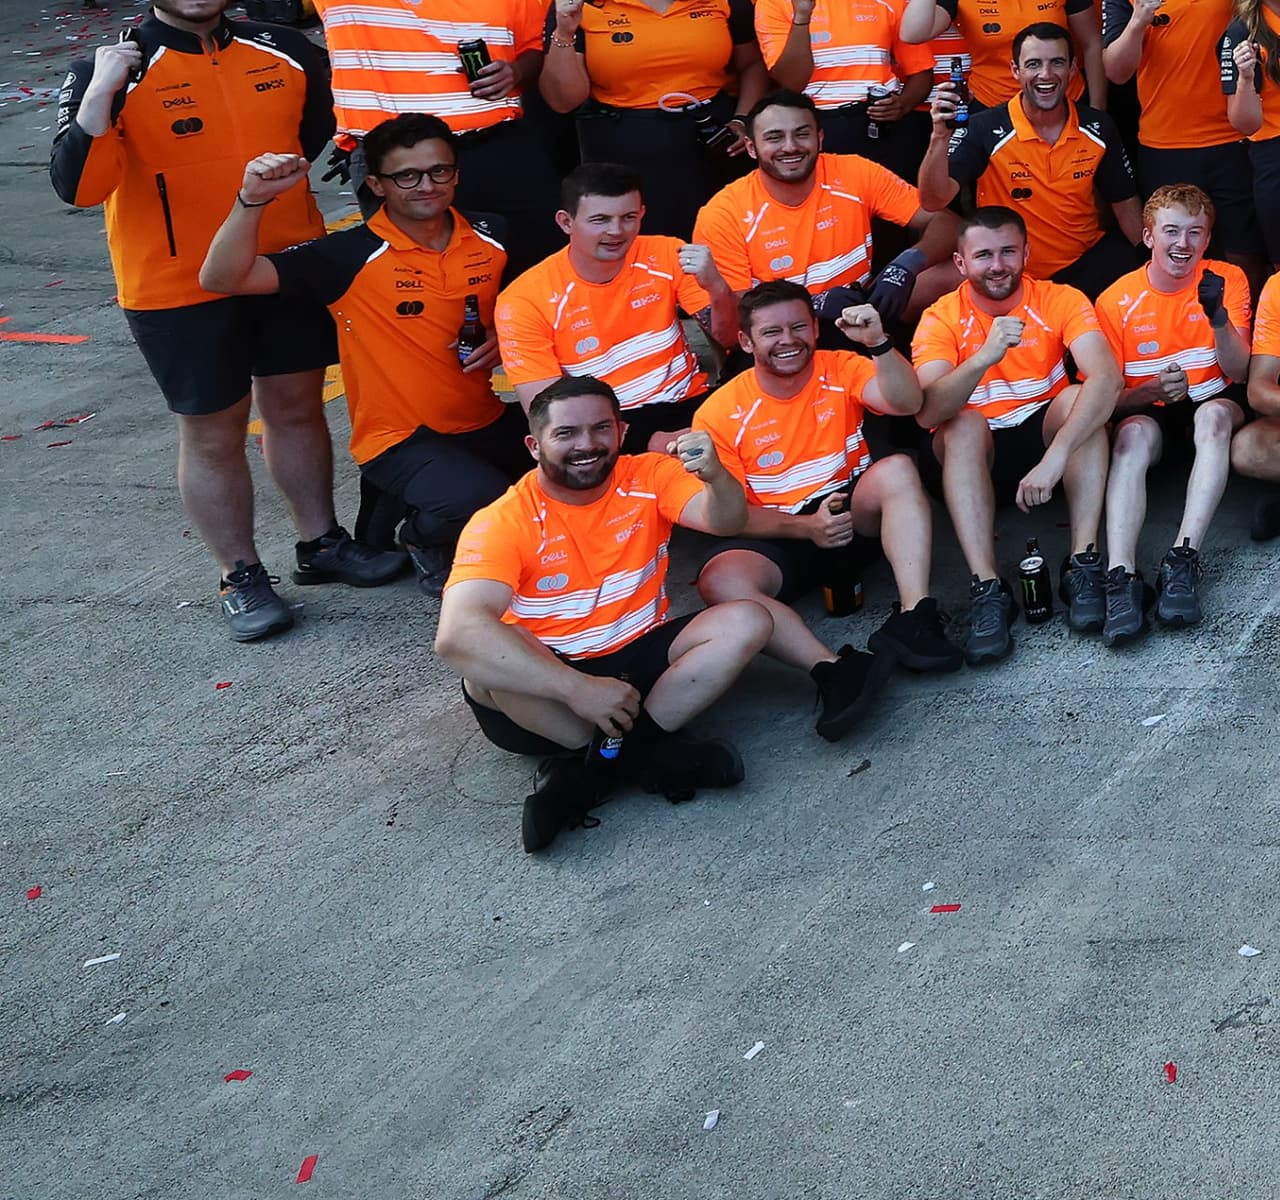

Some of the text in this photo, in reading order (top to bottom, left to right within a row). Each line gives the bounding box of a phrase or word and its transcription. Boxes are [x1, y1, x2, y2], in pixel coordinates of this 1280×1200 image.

[162, 96, 197, 109] DELL
[395, 280, 425, 290] DELL
[540, 549, 569, 565] DELL
